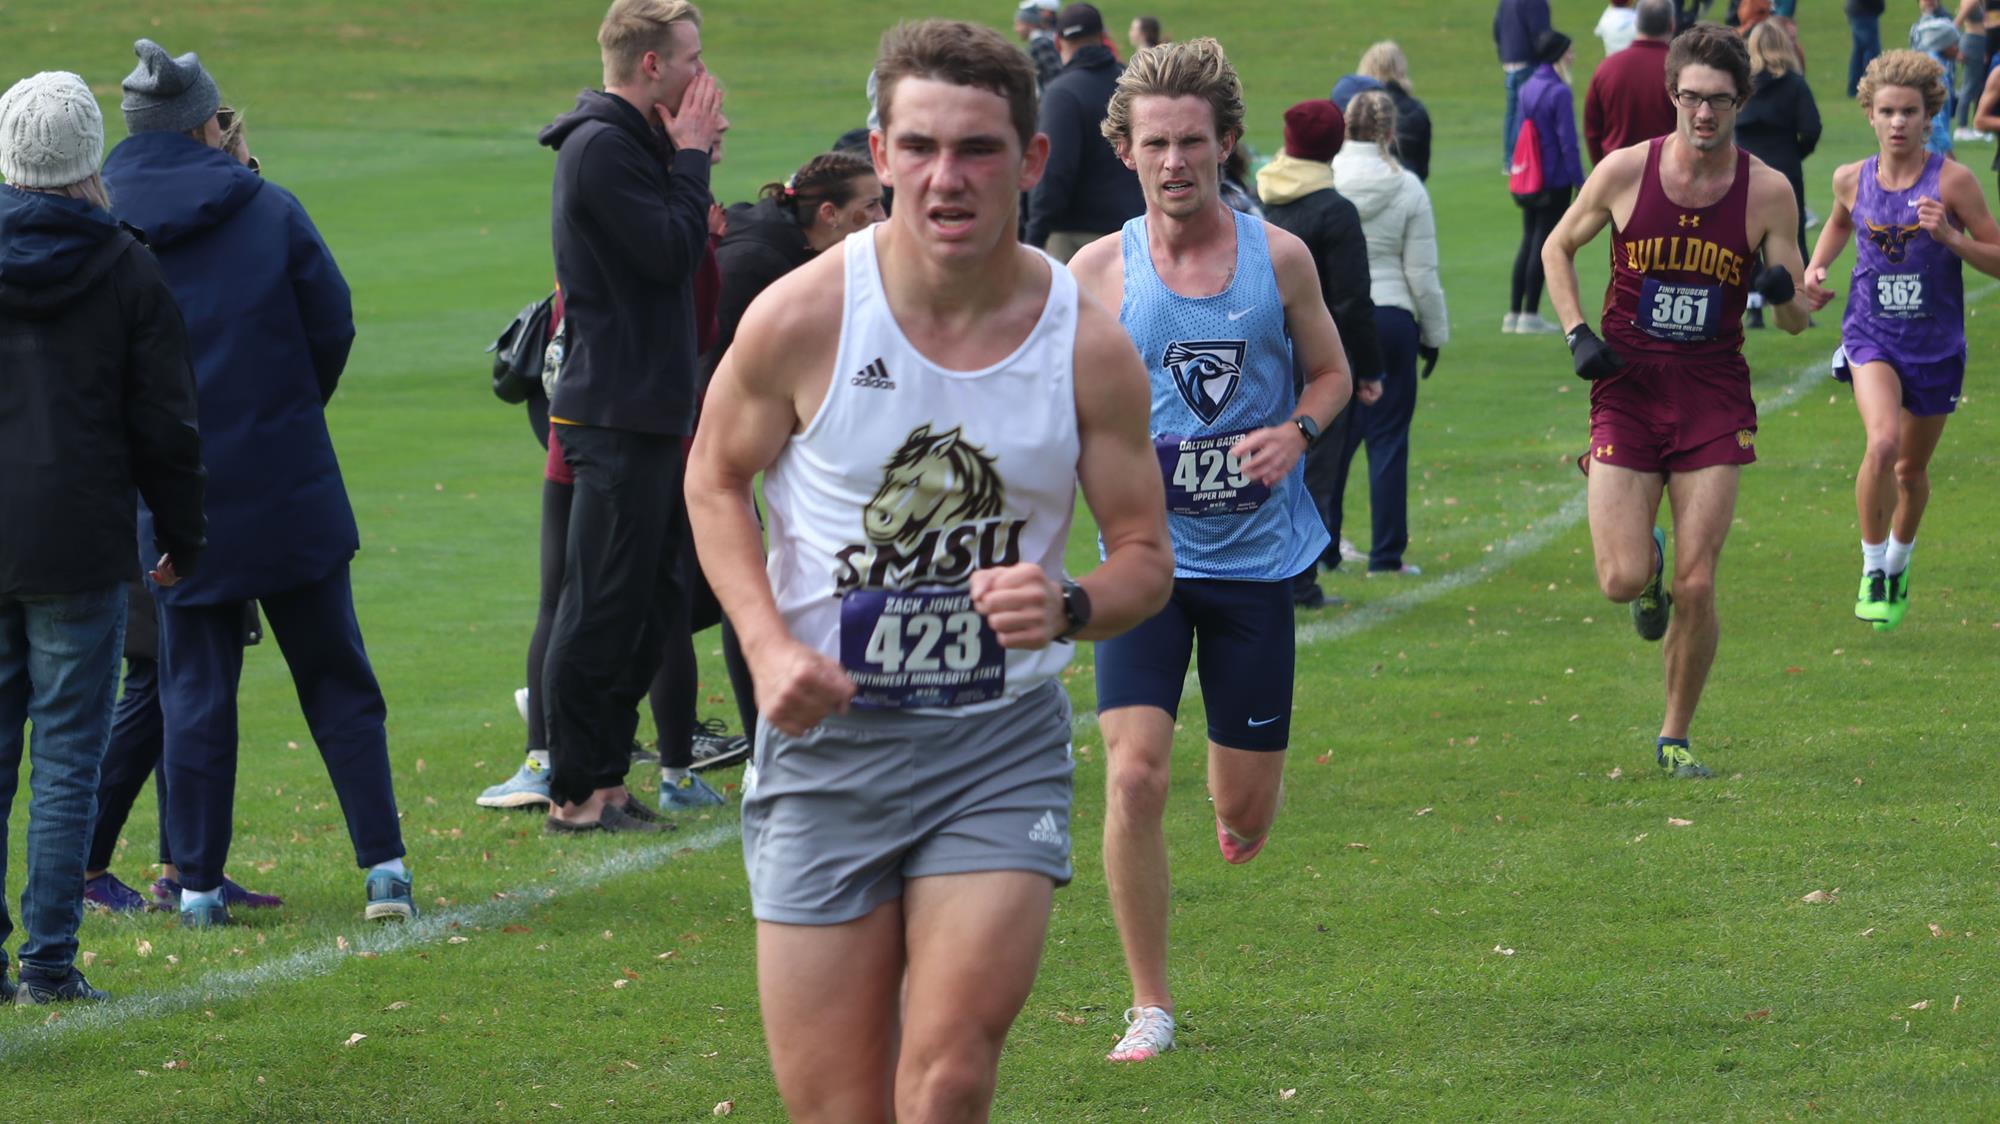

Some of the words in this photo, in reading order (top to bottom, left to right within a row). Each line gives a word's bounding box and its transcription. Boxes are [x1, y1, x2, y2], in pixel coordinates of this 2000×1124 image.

[1625, 236, 1744, 286] BULLDOGS
[1658, 285, 1676, 295] FINN
[1877, 281, 1923, 306] 362
[1651, 293, 1709, 326] 361
[851, 376, 896, 391] adidas
[1179, 439, 1216, 452] DALTON
[1172, 448, 1252, 493] 429
[1192, 491, 1217, 502] UPPER
[1218, 489, 1237, 500] IOWA
[832, 515, 1029, 598] SMSU
[884, 597, 923, 614] ZACK
[864, 611, 982, 674] 423
[910, 669, 972, 686] MINNESOTA
[973, 664, 1002, 681] STATE
[1028, 830, 1063, 845] adidas
